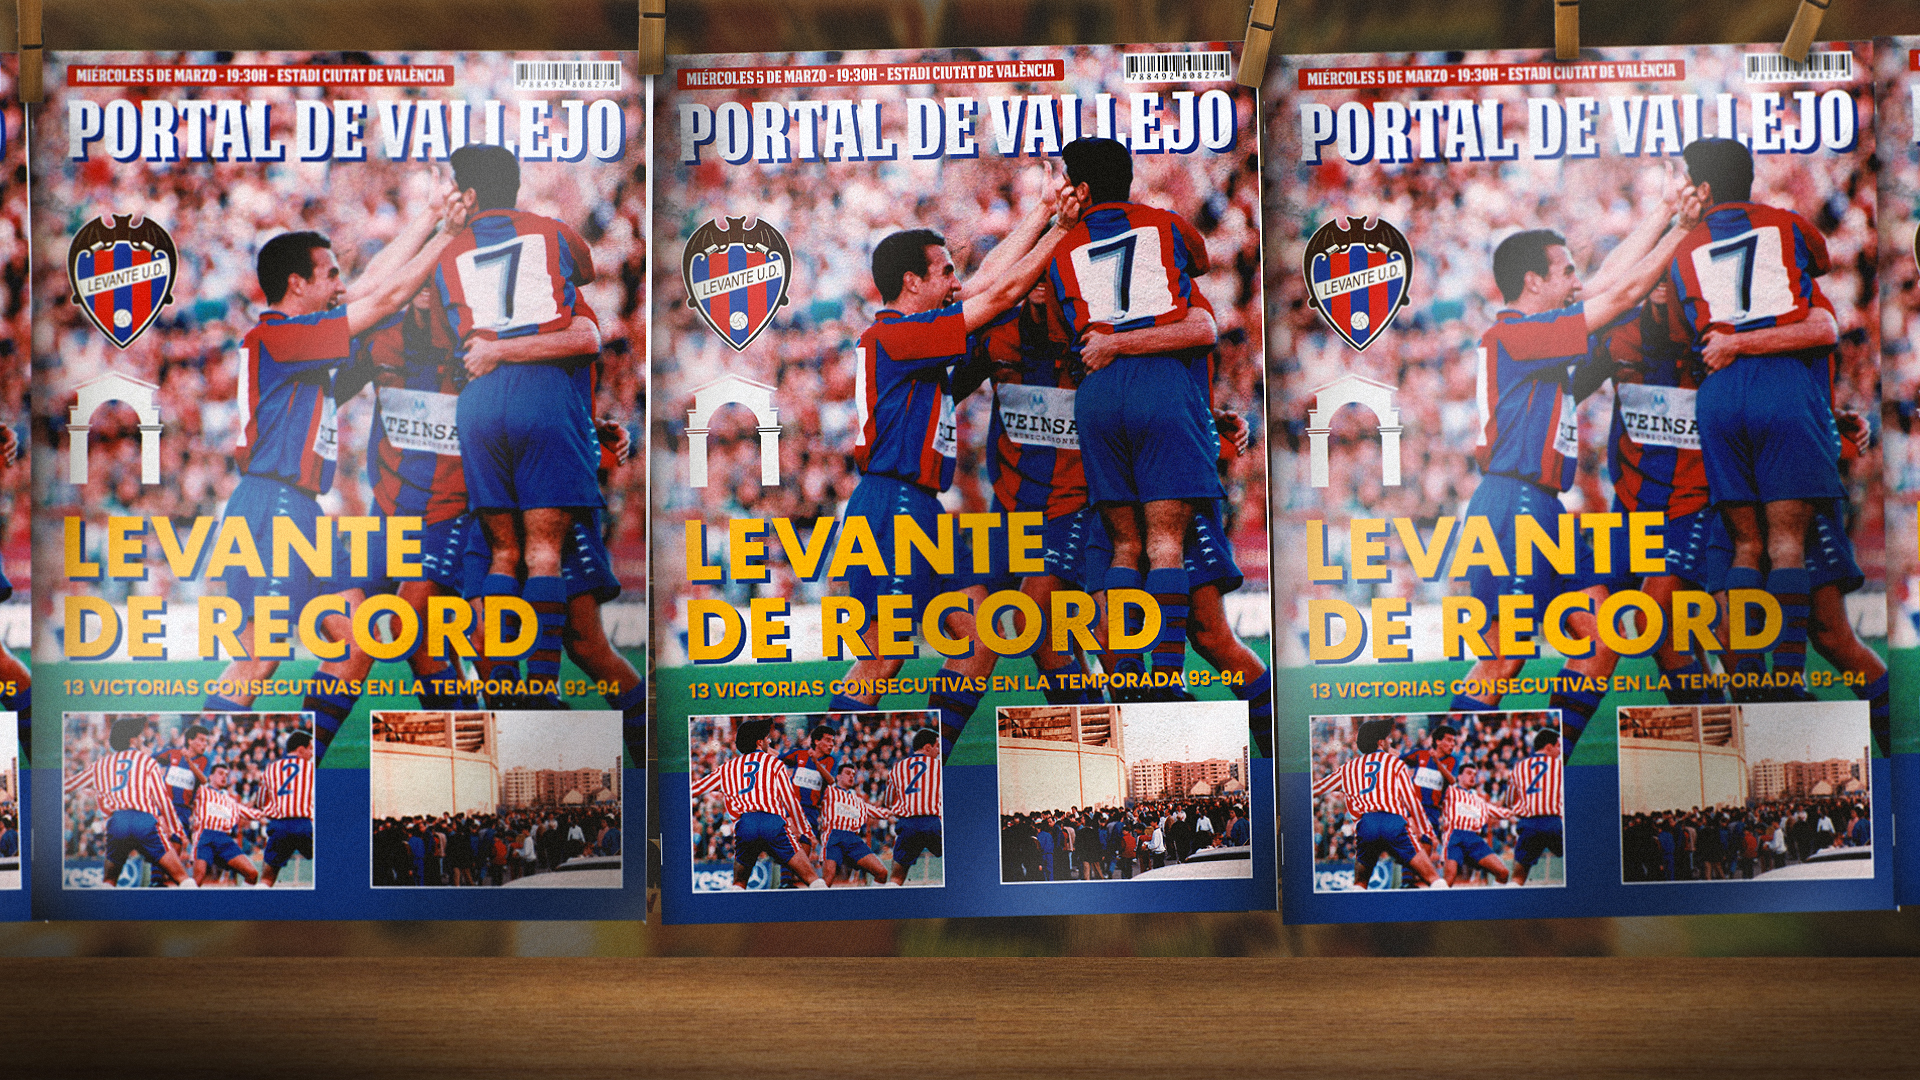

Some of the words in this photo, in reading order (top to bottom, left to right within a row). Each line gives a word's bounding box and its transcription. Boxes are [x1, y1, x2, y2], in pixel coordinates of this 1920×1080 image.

[76, 65, 144, 82] MIÉRCOLES
[146, 68, 154, 82] 5
[156, 68, 172, 82] DE
[174, 68, 216, 82] MARZO
[226, 68, 268, 82] 19:30H
[277, 68, 320, 82] ESTADI
[323, 68, 366, 82] CIUTAT
[369, 68, 384, 82] DE
[386, 65, 445, 82] VALÈNCIA
[686, 68, 755, 86] MIÉRCOLES
[756, 71, 764, 84] 5
[766, 70, 782, 84] DE
[784, 68, 827, 83] MARZO
[836, 67, 878, 82] 19:30H
[887, 66, 930, 81] ESTADI
[932, 65, 976, 80] CIUTAT
[978, 65, 994, 78] DE
[996, 61, 1055, 78] VALÈNCIA
[1307, 68, 1376, 86] MIÉRCOLES
[1377, 71, 1385, 84] 5
[1387, 70, 1403, 84] DE
[1405, 68, 1448, 83] MARZO
[1457, 67, 1499, 82] 19:30H
[1508, 66, 1551, 81] ESTADI
[1553, 65, 1596, 80] CIUTAT
[1599, 64, 1615, 79] DE
[1617, 60, 1676, 78] VALÈNCIA
[67, 99, 285, 162] PORTAL
[296, 99, 368, 162] DE
[376, 98, 626, 163] VALLEJO
[678, 98, 898, 165] PORTAL
[906, 96, 979, 160] DE
[988, 89, 1238, 158] VALLEJO
[1300, 98, 1519, 165] PORTAL
[1527, 96, 1600, 160] DE
[1609, 89, 1859, 159] VALLEJO
[88, 268, 139, 293] LEVANTE
[142, 263, 165, 279] U.D.
[473, 241, 524, 322] 7
[703, 270, 754, 296] LEVANTE
[757, 264, 780, 281] U.D.
[1087, 234, 1138, 317] 7
[1324, 270, 1375, 296] LEVANTE
[1378, 264, 1400, 281] U.D.
[1708, 234, 1759, 317] 7
[386, 416, 461, 442] TEINSA
[1004, 412, 1079, 435] TEINSA
[1625, 411, 1701, 436] TEINSA
[63, 516, 427, 582] LEVANTE
[685, 511, 1049, 585] LEVANTE
[1306, 511, 1671, 585] LEVANTE
[63, 596, 167, 662] DE
[198, 594, 543, 663] RECORD
[687, 597, 792, 664] DE
[821, 588, 1166, 662] RECORD
[1308, 597, 1413, 664] DE
[1441, 588, 1787, 662] RECORD
[63, 679, 85, 697] 13
[89, 679, 199, 697] VICTORIAS
[204, 679, 362, 697] CONSECUTIVAS
[368, 679, 394, 697] EN
[399, 679, 426, 697] LA
[431, 679, 558, 697] TEMPORADA
[688, 683, 710, 699] 13
[715, 680, 825, 698] VICTORIAS
[829, 676, 988, 696] CONSECUTIVAS
[992, 676, 1020, 693] EN
[1024, 674, 1051, 691] LA
[1056, 671, 1184, 691] TEMPORADA
[1309, 683, 1331, 699] 13
[1335, 680, 1446, 698] VICTORIAS
[1450, 676, 1609, 696] CONSECUTIVAS
[1613, 676, 1642, 693] EN
[1645, 674, 1671, 691] LA
[1677, 672, 1805, 691] TEMPORADA
[111, 759, 132, 792] 3
[277, 763, 300, 796] 2
[738, 761, 760, 795] 3
[904, 761, 927, 794] 2
[1359, 761, 1381, 794] 3
[1526, 760, 1548, 794] 2
